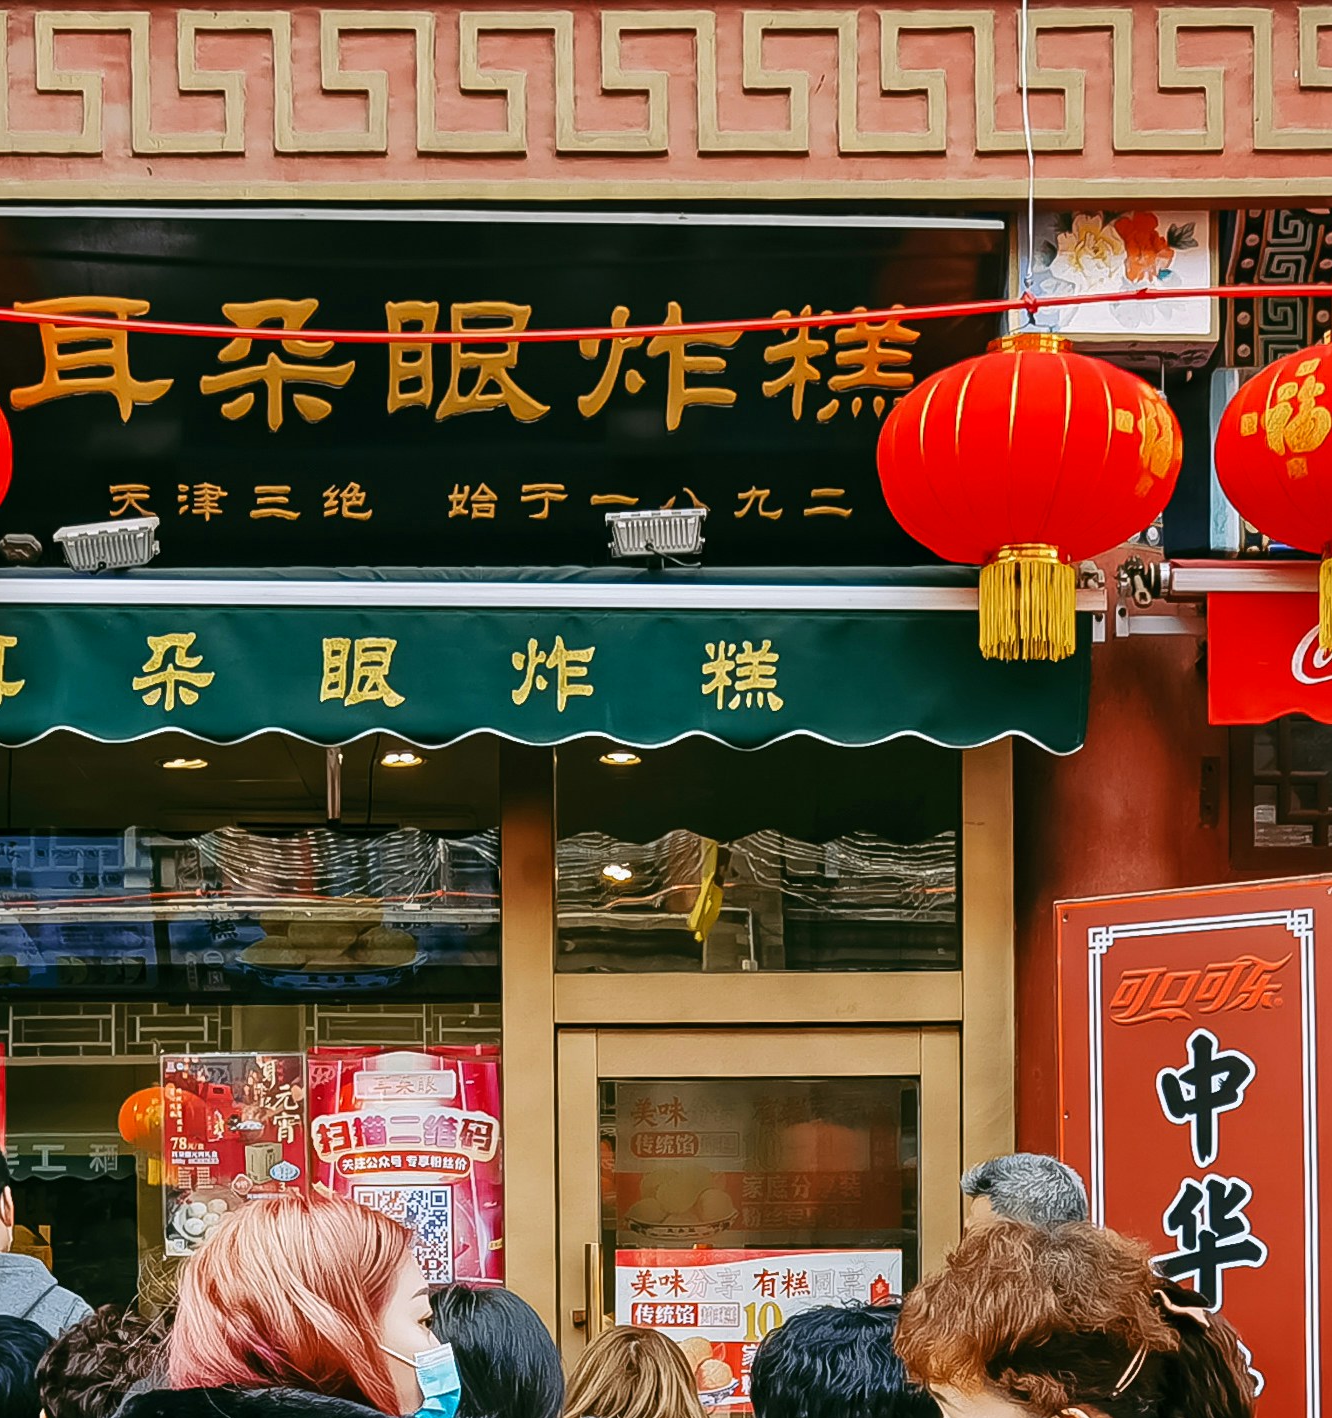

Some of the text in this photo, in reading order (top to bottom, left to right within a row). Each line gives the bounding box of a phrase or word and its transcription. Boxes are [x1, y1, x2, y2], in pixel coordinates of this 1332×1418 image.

[10, 296, 921, 432] 耳朵眼炸糕
[109, 482, 852, 521] 天津三绝 始于一八九二
[1109, 952, 1293, 1027] 可口可乐
[271, 1083, 301, 1145] 元宵
[316, 1114, 494, 1155] 扫描二维码
[342, 1155, 468, 1171] 关注公众号 专享粉丝价
[635, 1134, 696, 1156] 传统馅
[1150, 1028, 1268, 1398] 中华
[631, 1268, 744, 1299] 美味分享
[635, 1303, 696, 1325] 传统馅
[743, 1301, 784, 1342] 10
